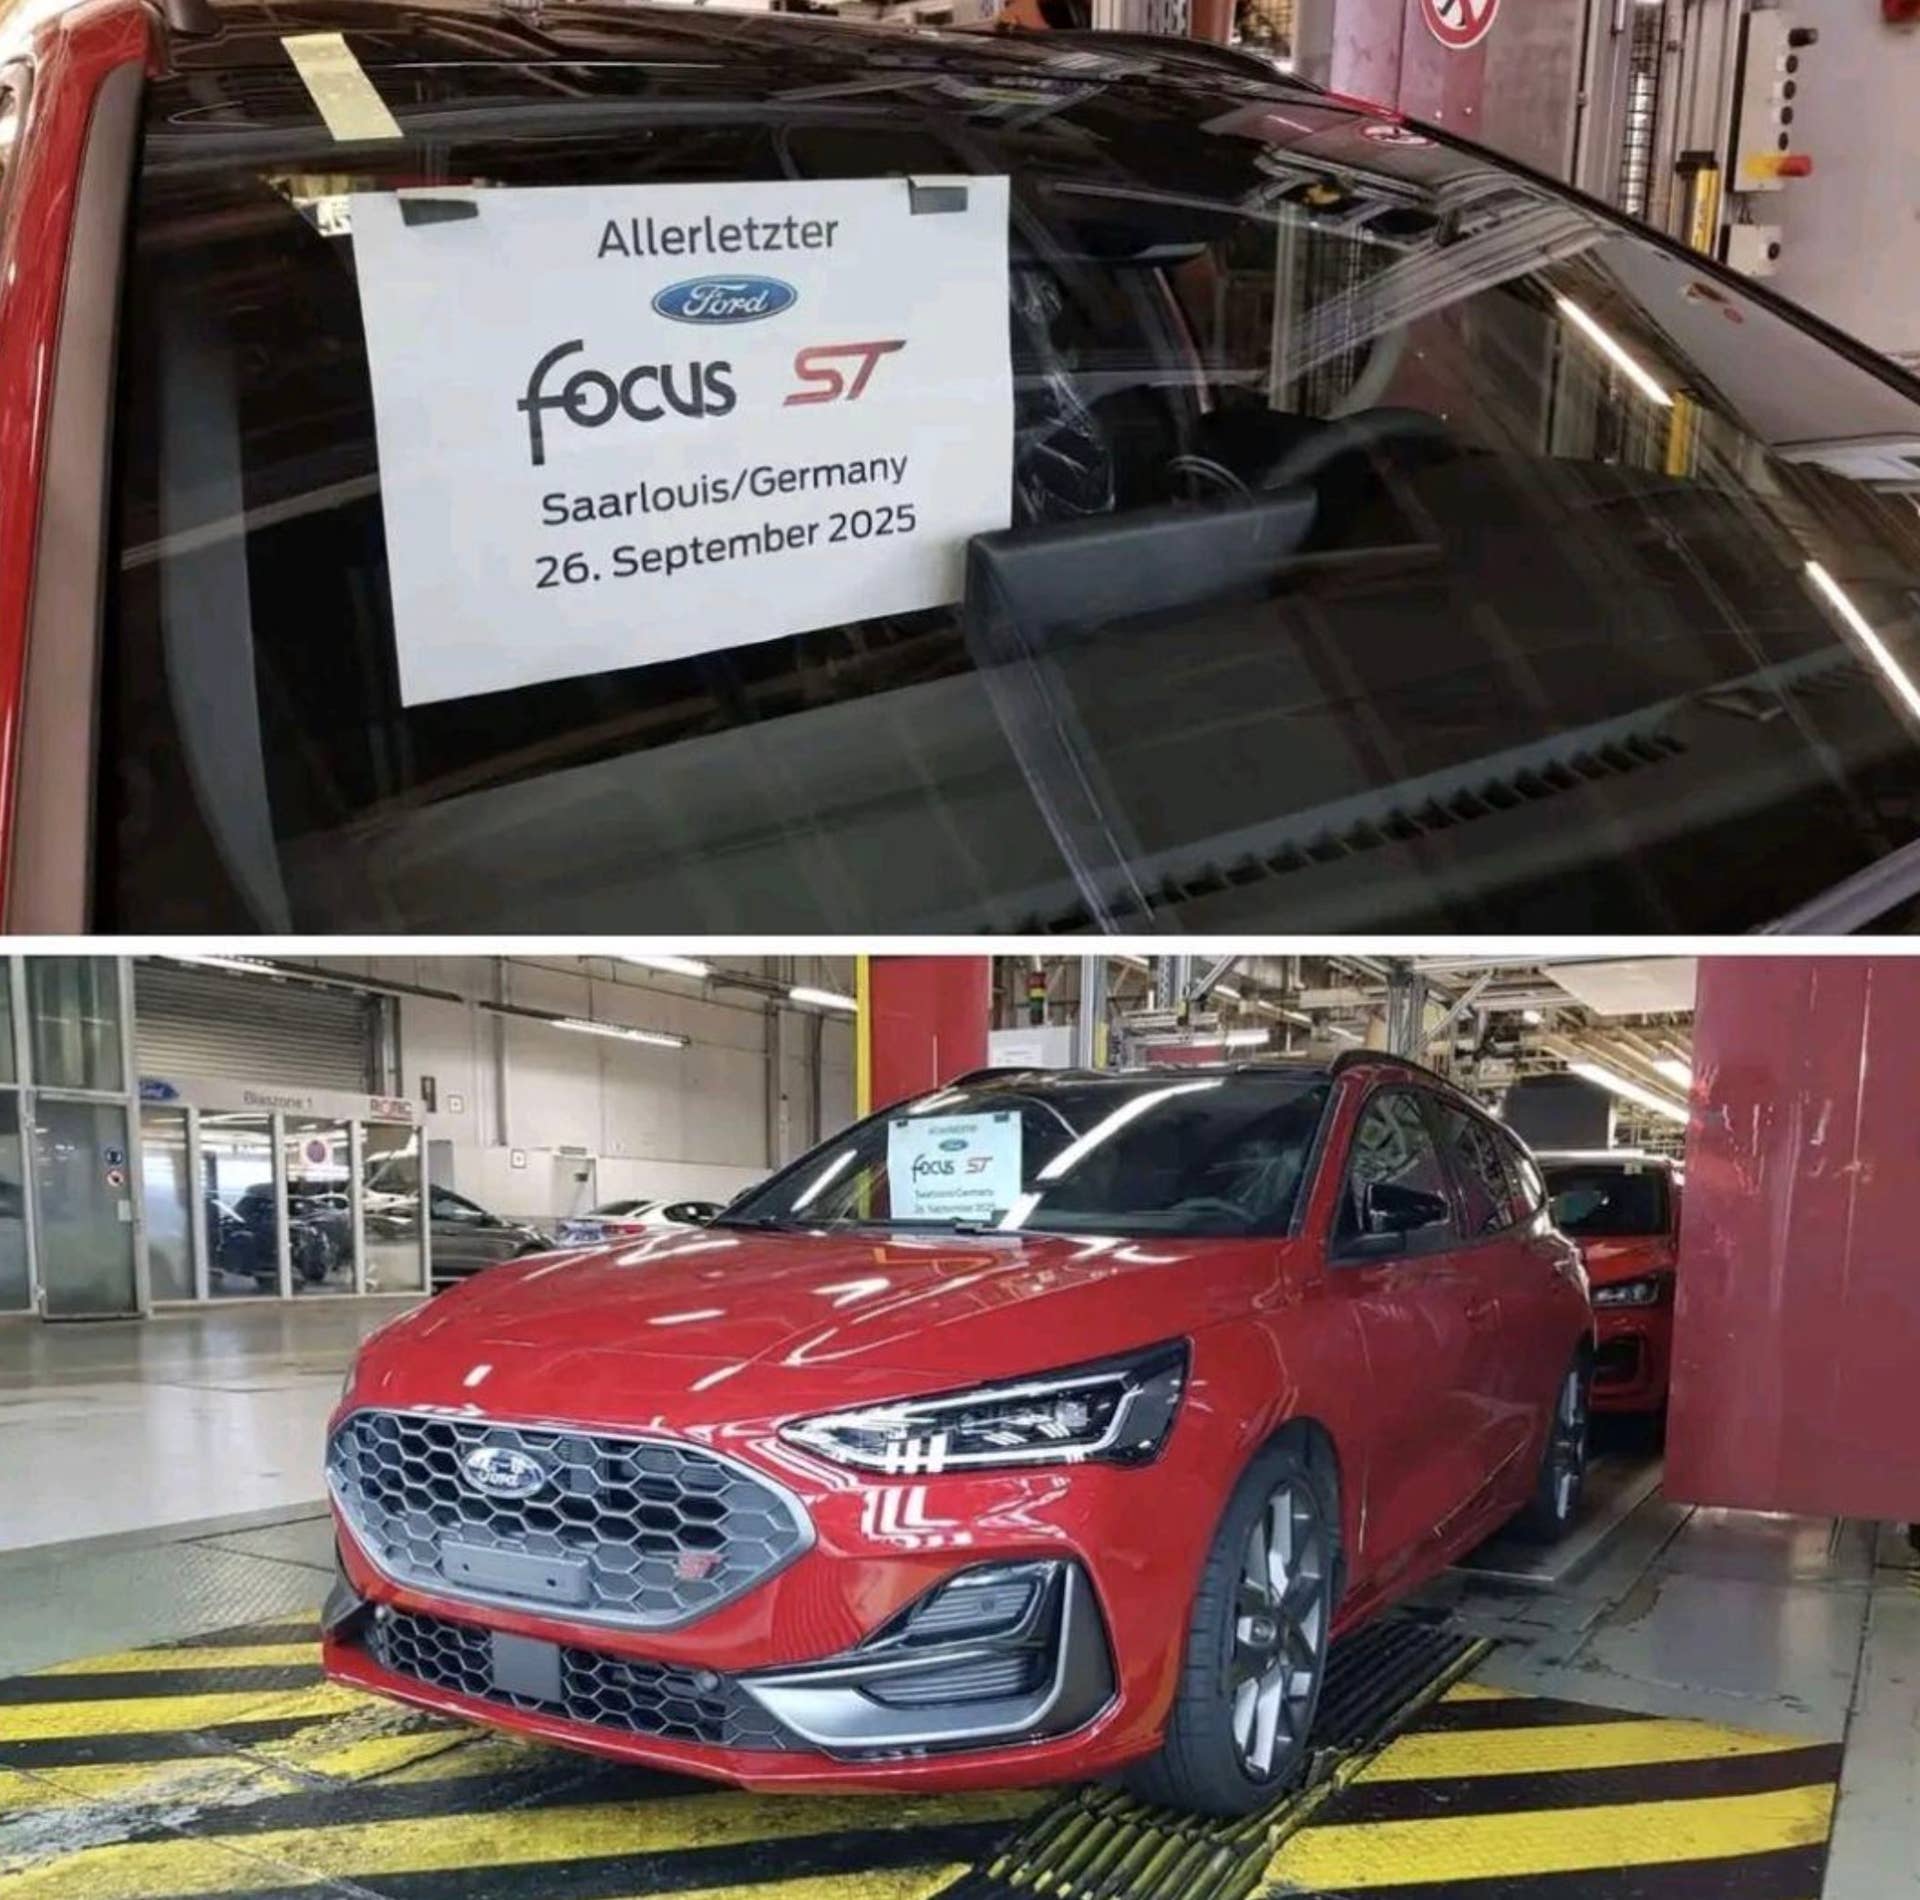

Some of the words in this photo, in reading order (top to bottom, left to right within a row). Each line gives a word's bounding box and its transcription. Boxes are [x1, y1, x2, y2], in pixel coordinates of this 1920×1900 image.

[597, 215, 839, 259] Allerletzter
[682, 283, 769, 316] Ford
[783, 339, 907, 406] ST
[542, 455, 909, 526] Saarlouis/Germany
[535, 551, 601, 589] 26.
[612, 523, 820, 578] September
[828, 504, 917, 544] 2025
[964, 1156, 993, 1174] ST
